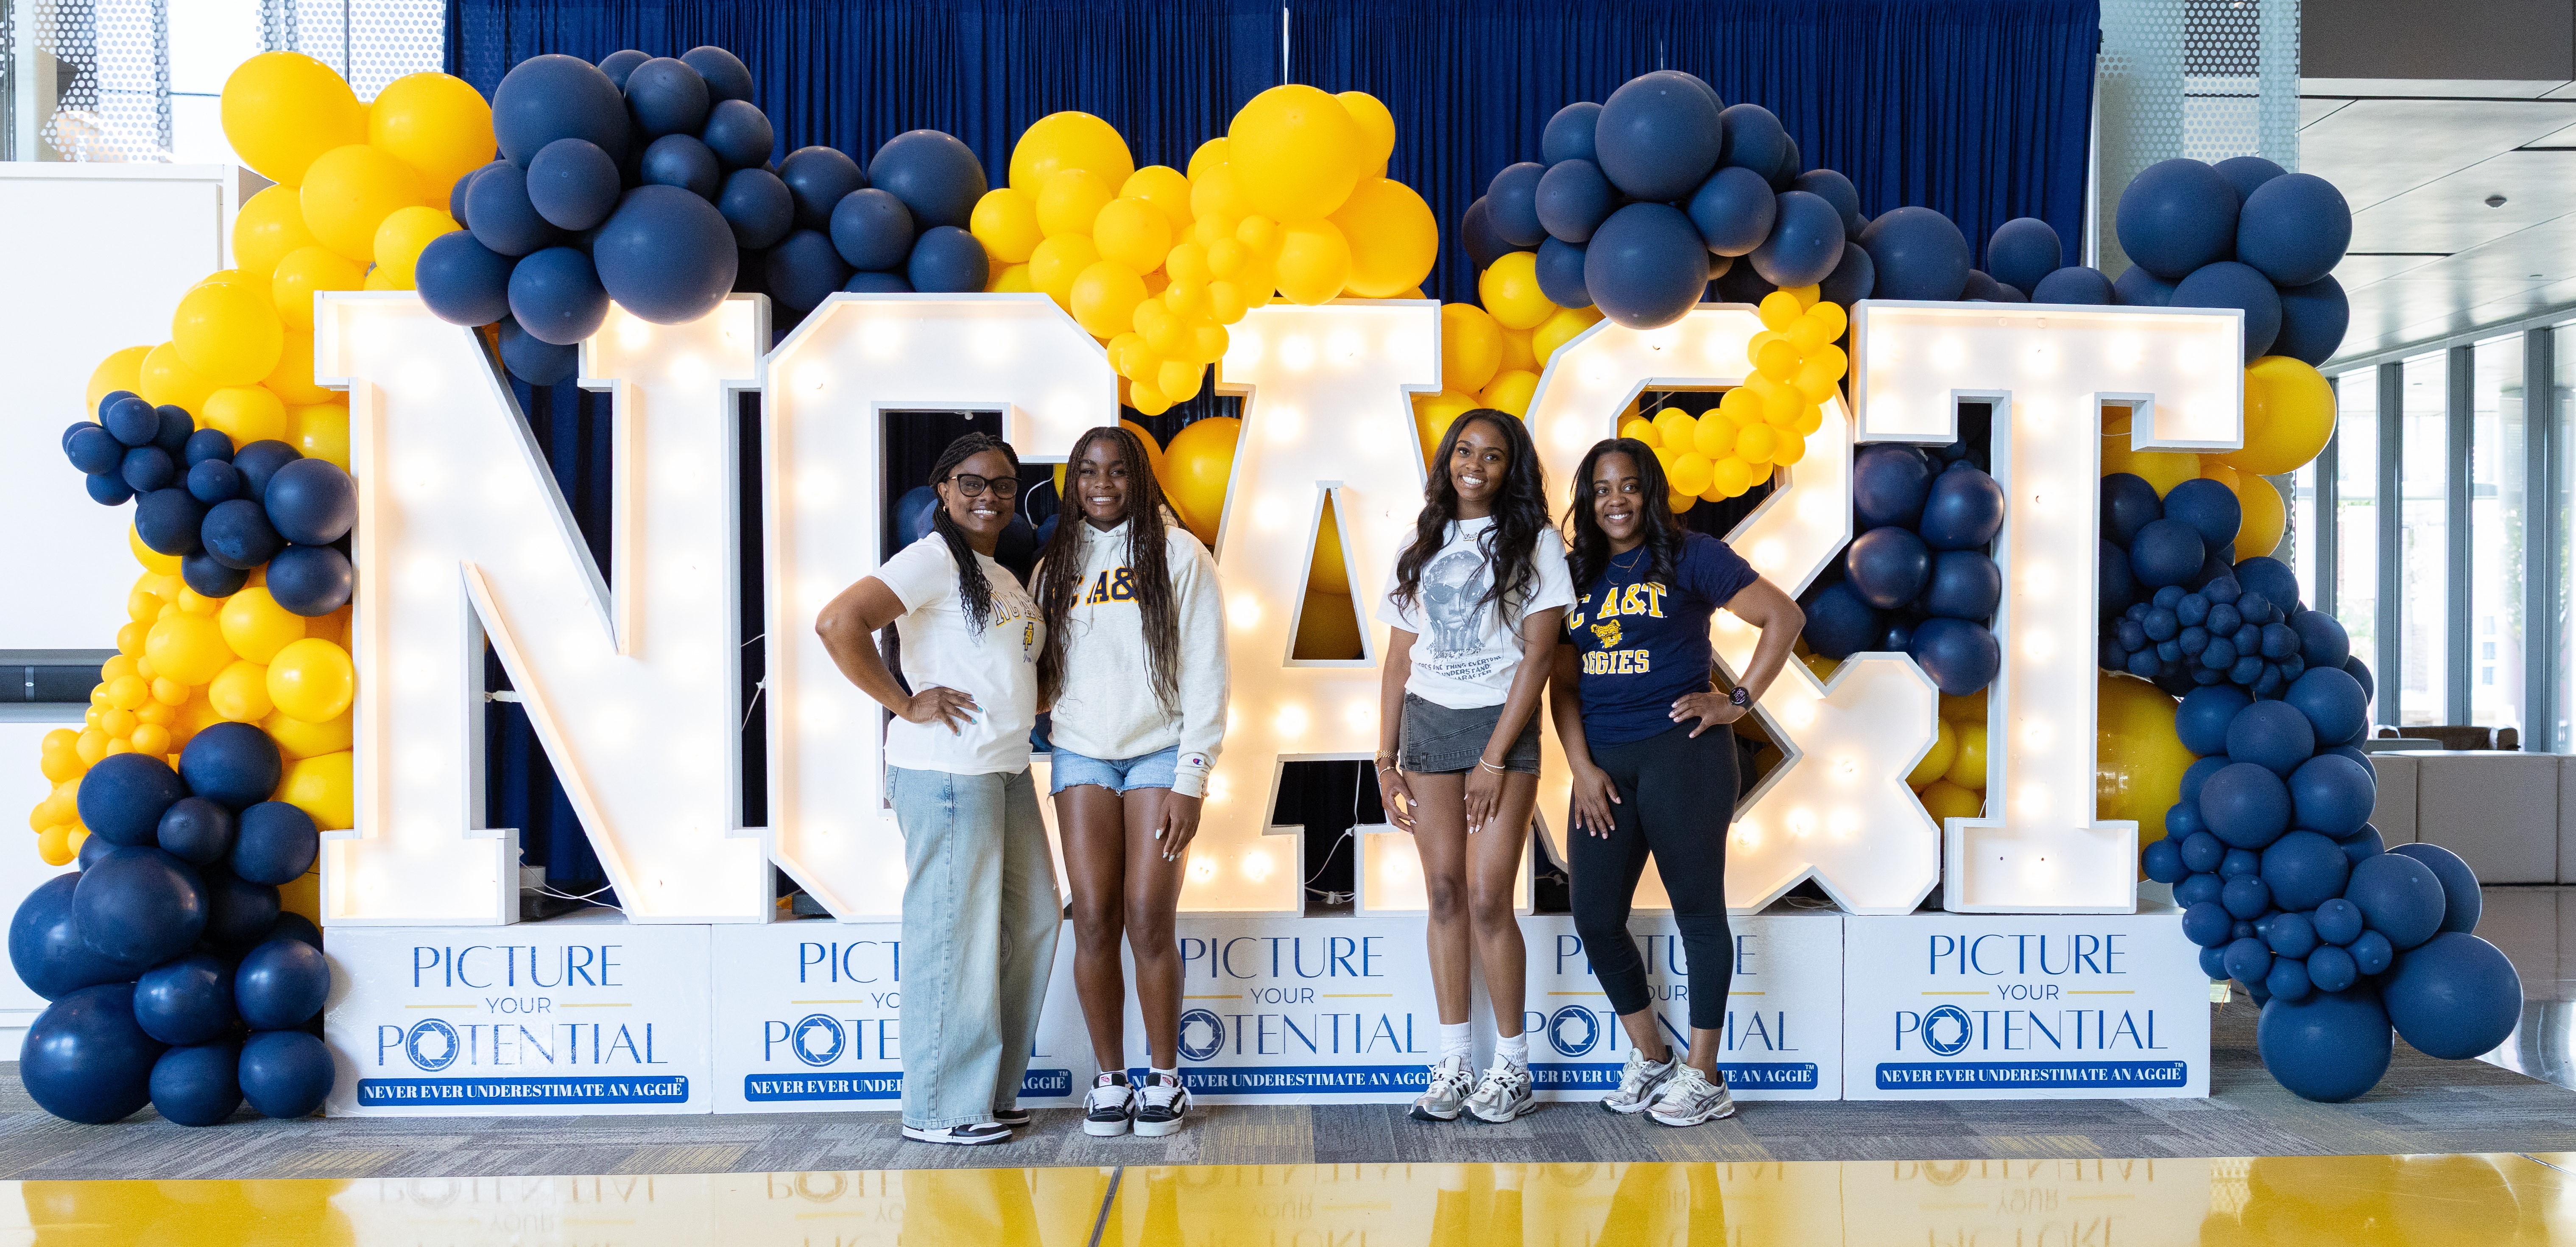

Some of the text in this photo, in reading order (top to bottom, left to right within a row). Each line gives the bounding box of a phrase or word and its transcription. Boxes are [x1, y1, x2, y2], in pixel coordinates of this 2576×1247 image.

[1597, 582, 1667, 620] A&T
[1468, 656, 1502, 667] EVERYONE
[800, 941, 901, 983] PICT
[1181, 937, 1384, 979] PICTURE
[1929, 934, 2127, 975] PICTURE
[414, 945, 623, 988] PICTURE
[1250, 988, 1314, 1004] YOUR
[1997, 984, 2059, 1000] YOUR
[486, 998, 551, 1014] YOUR
[871, 993, 900, 1008] YO
[1146, 1009, 1428, 1062] OTENTIAL
[1188, 1074, 1229, 1087] EVER
[1232, 1073, 1365, 1087] UNDERESTIMATE
[1369, 1073, 1390, 1085] AN
[1393, 1073, 1431, 1085] AGGI
[1530, 1070, 1559, 1082] VER
[1562, 1070, 1602, 1082] EVER
[1741, 1070, 1761, 1082] AN
[1882, 1069, 1932, 1083] NEVER
[1935, 1069, 1976, 1082] EVER
[1979, 1068, 2108, 1082] UNDERESTIMATE
[2110, 1068, 2132, 1081] AN
[364, 1085, 418, 1099] NEVER
[421, 1085, 463, 1098] EVER
[467, 1083, 604, 1098] UNDERESTIMATE
[608, 1083, 632, 1096] AN
[751, 1081, 804, 1094] NEVER
[807, 1079, 849, 1093] EVER
